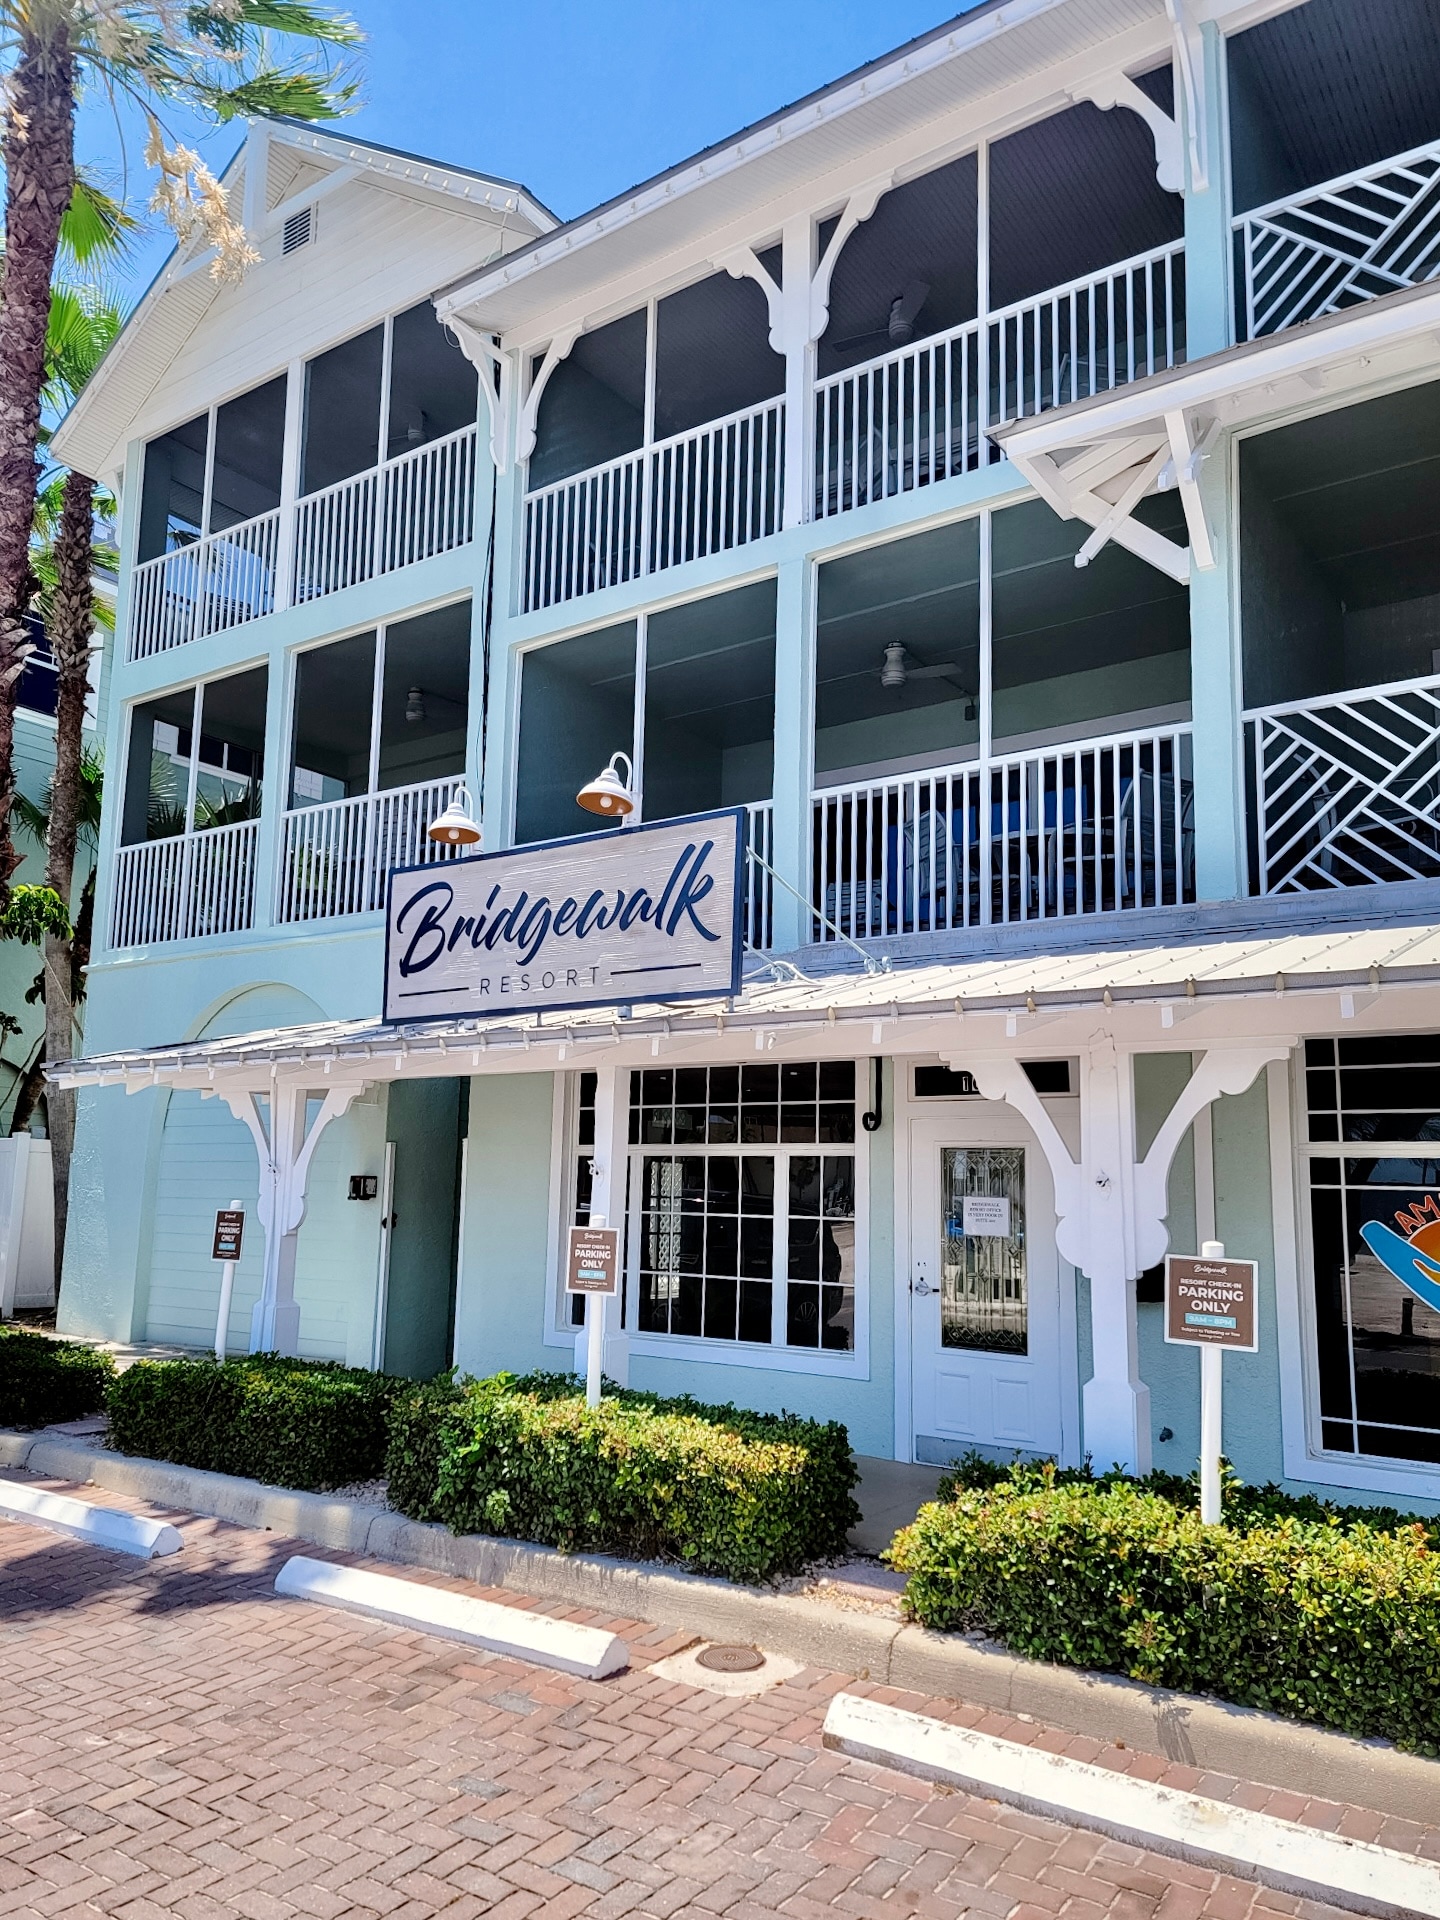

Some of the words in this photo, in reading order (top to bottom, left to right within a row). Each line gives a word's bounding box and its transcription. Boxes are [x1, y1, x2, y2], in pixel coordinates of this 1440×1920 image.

[397, 840, 721, 978] Bridgewalk
[480, 966, 600, 995] RESORT
[1394, 1192, 1440, 1234] AM
[574, 1249, 611, 1259] PARKING
[581, 1260, 604, 1269] ONLY
[1180, 1278, 1207, 1286] RESORT
[1208, 1280, 1242, 1289] CHECK-IN
[1178, 1285, 1244, 1302] PARKING
[1191, 1300, 1231, 1313] ONLY
